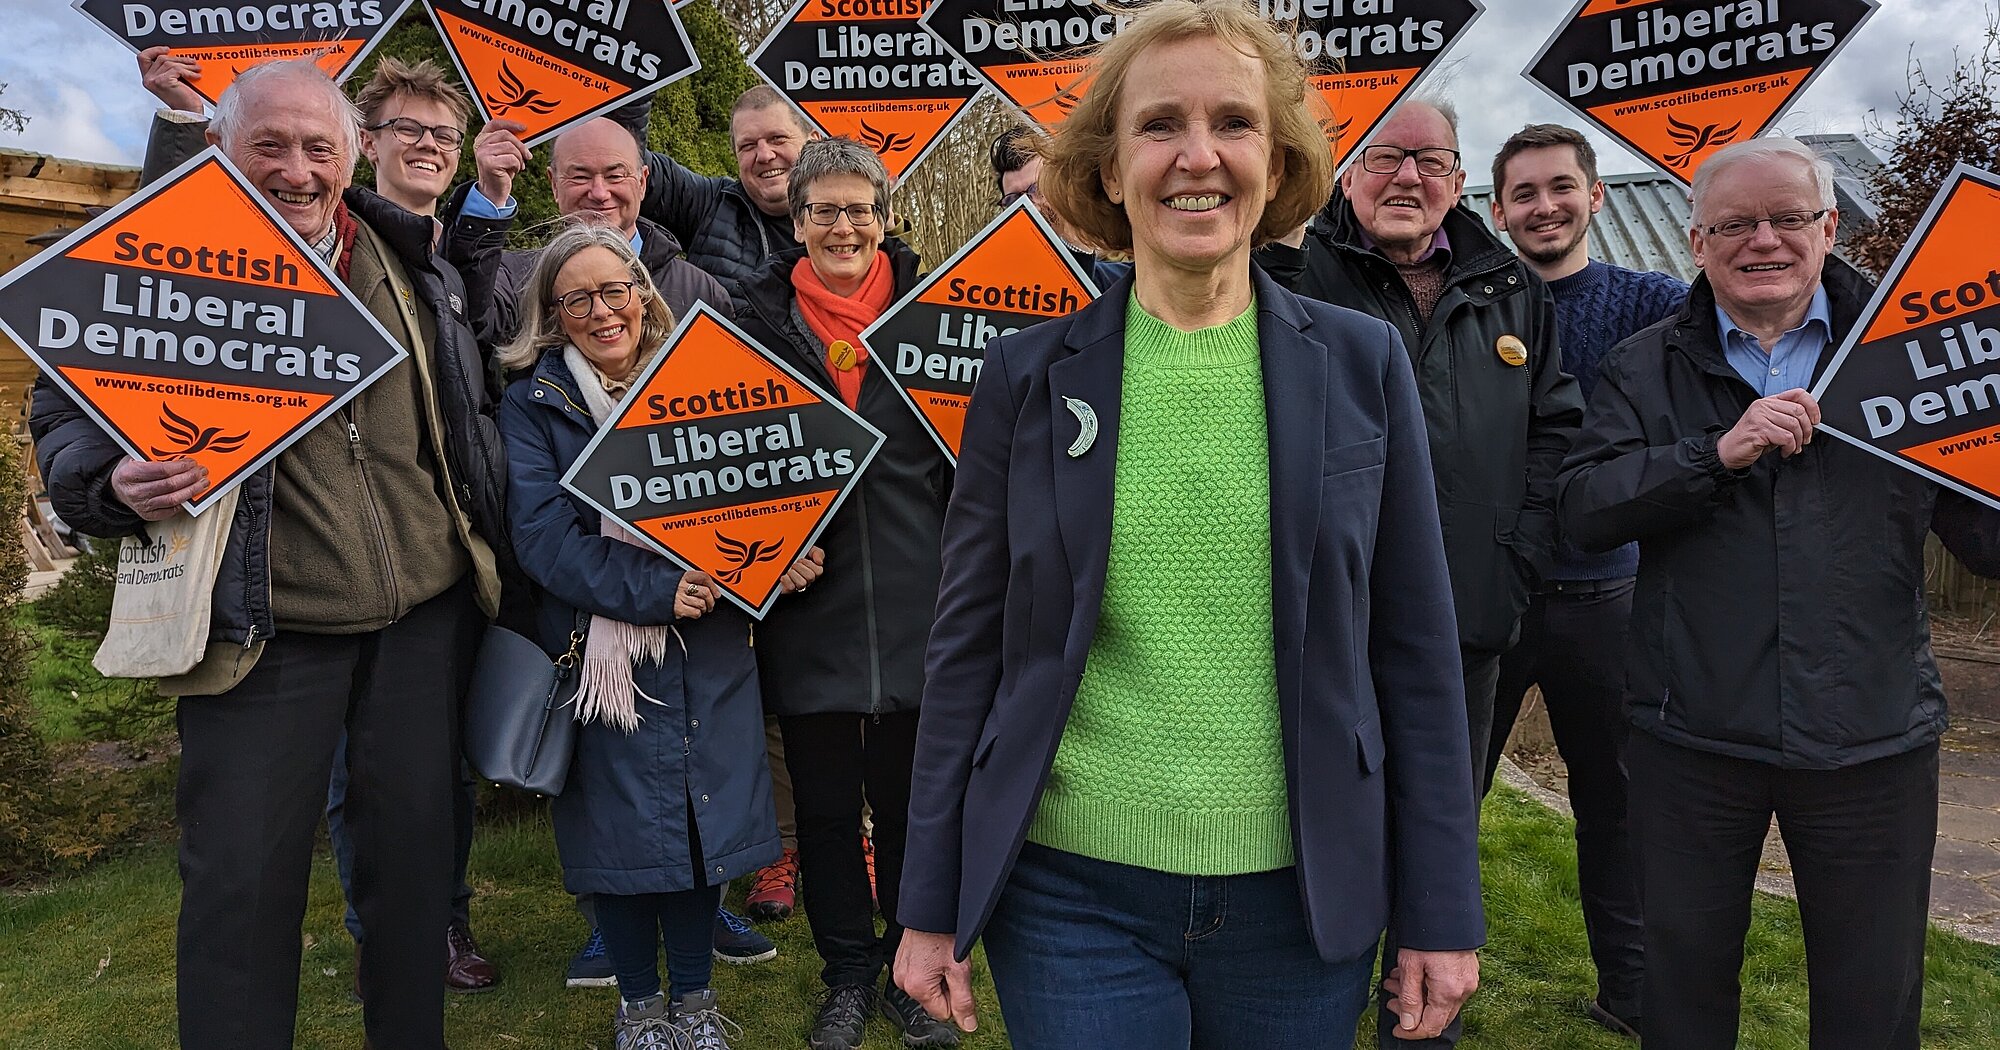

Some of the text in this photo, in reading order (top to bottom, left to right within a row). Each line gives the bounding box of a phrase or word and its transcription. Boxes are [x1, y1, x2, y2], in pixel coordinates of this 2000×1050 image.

[122, 0, 384, 37] Democrats
[461, 0, 662, 81] mocrats
[962, 13, 1134, 53] Democr
[1281, 16, 1444, 61] ocrats
[1610, 0, 1779, 53] Liberal
[459, 24, 611, 94] www.scotlibdems.org.uk
[1567, 21, 1837, 98] Democrats
[820, 101, 950, 114] www.scotlibdems.org.uk
[1613, 76, 1790, 117] www.scotlibdems.org.uk
[114, 231, 299, 287] Scottish
[102, 273, 306, 338] Liberal
[948, 277, 1079, 314] Scottish
[37, 307, 362, 383] Democrats
[938, 312, 1020, 350] Lib
[94, 376, 308, 409] www.scotlibdems.org.uk
[647, 378, 789, 420] Scottish
[647, 412, 804, 467] Liberal
[609, 447, 855, 510] Democrats
[661, 497, 822, 531] www.scotlibdems.org.uk
